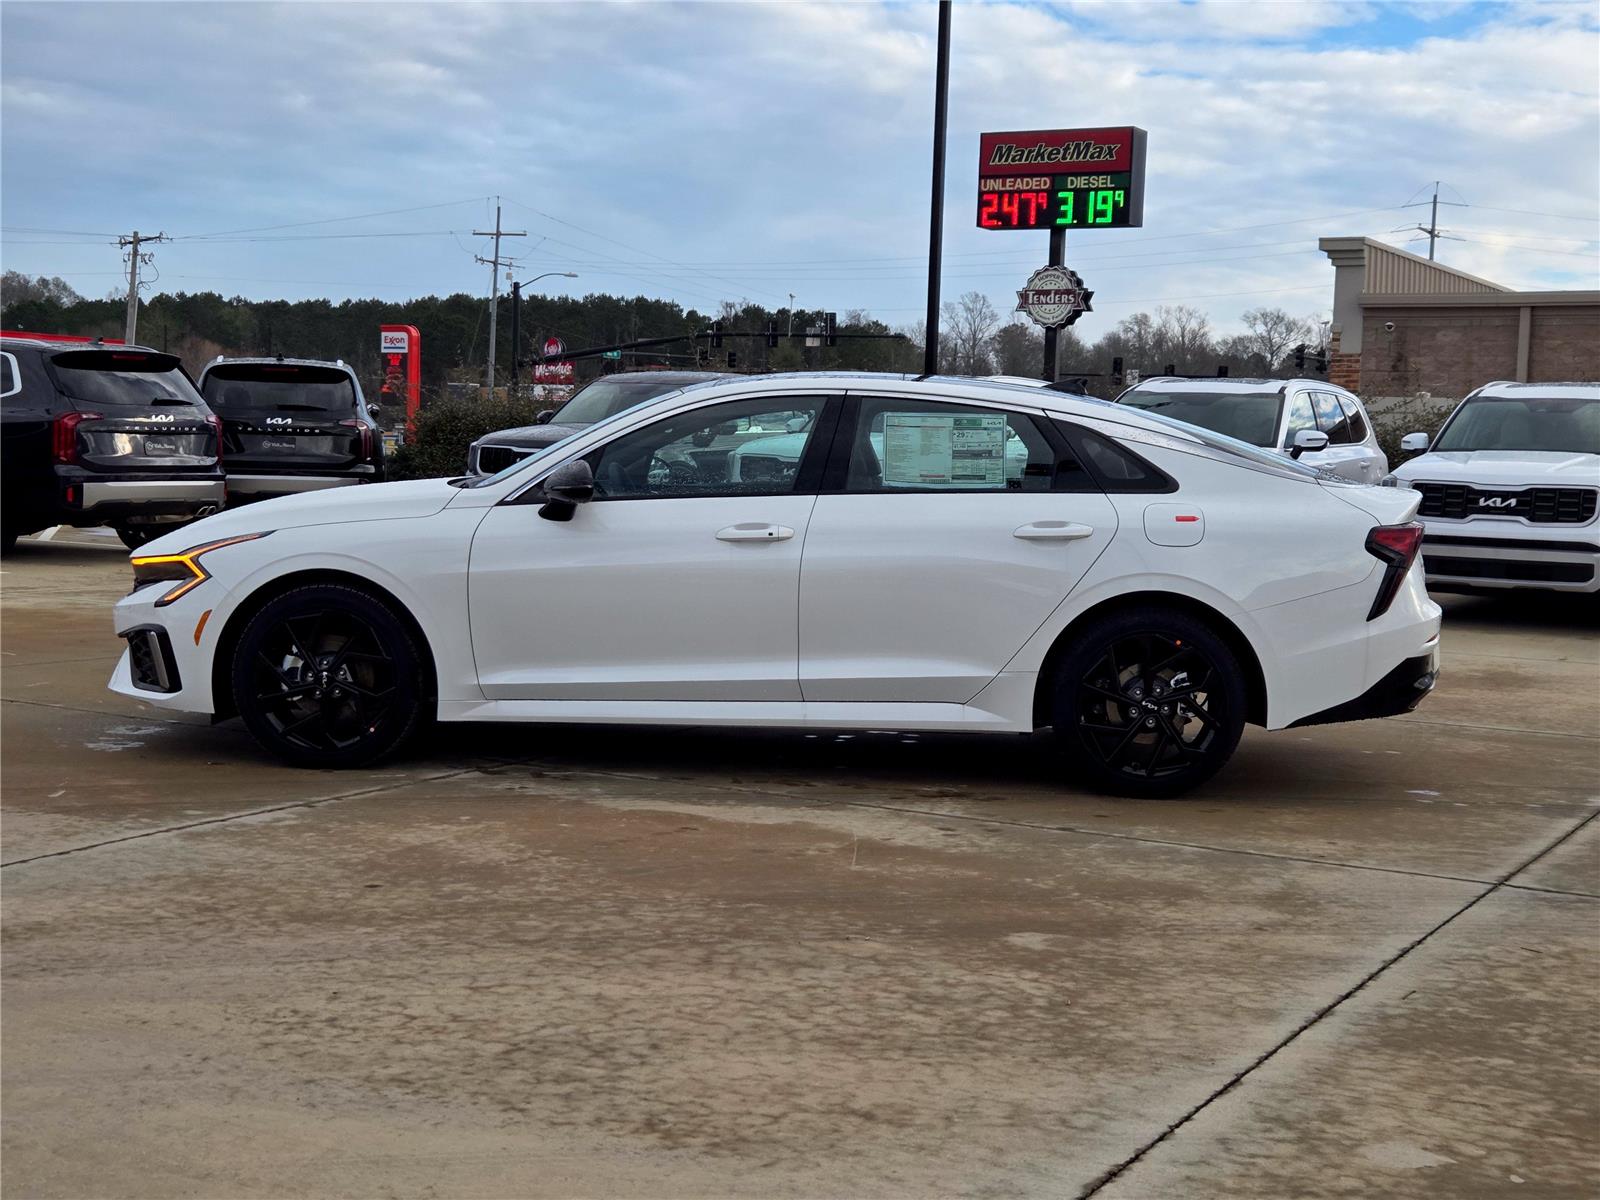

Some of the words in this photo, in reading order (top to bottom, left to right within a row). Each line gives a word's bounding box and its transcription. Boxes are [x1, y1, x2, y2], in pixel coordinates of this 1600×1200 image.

[990, 141, 1121, 165] MarketMax
[981, 177, 1050, 191] UNLEADED
[1067, 176, 1115, 189] DIESEL
[384, 336, 405, 345] Exxon
[151, 414, 174, 423] KIA
[266, 417, 292, 425] KIA
[237, 424, 320, 433] TELLURIDE
[1479, 497, 1517, 508] KIA
